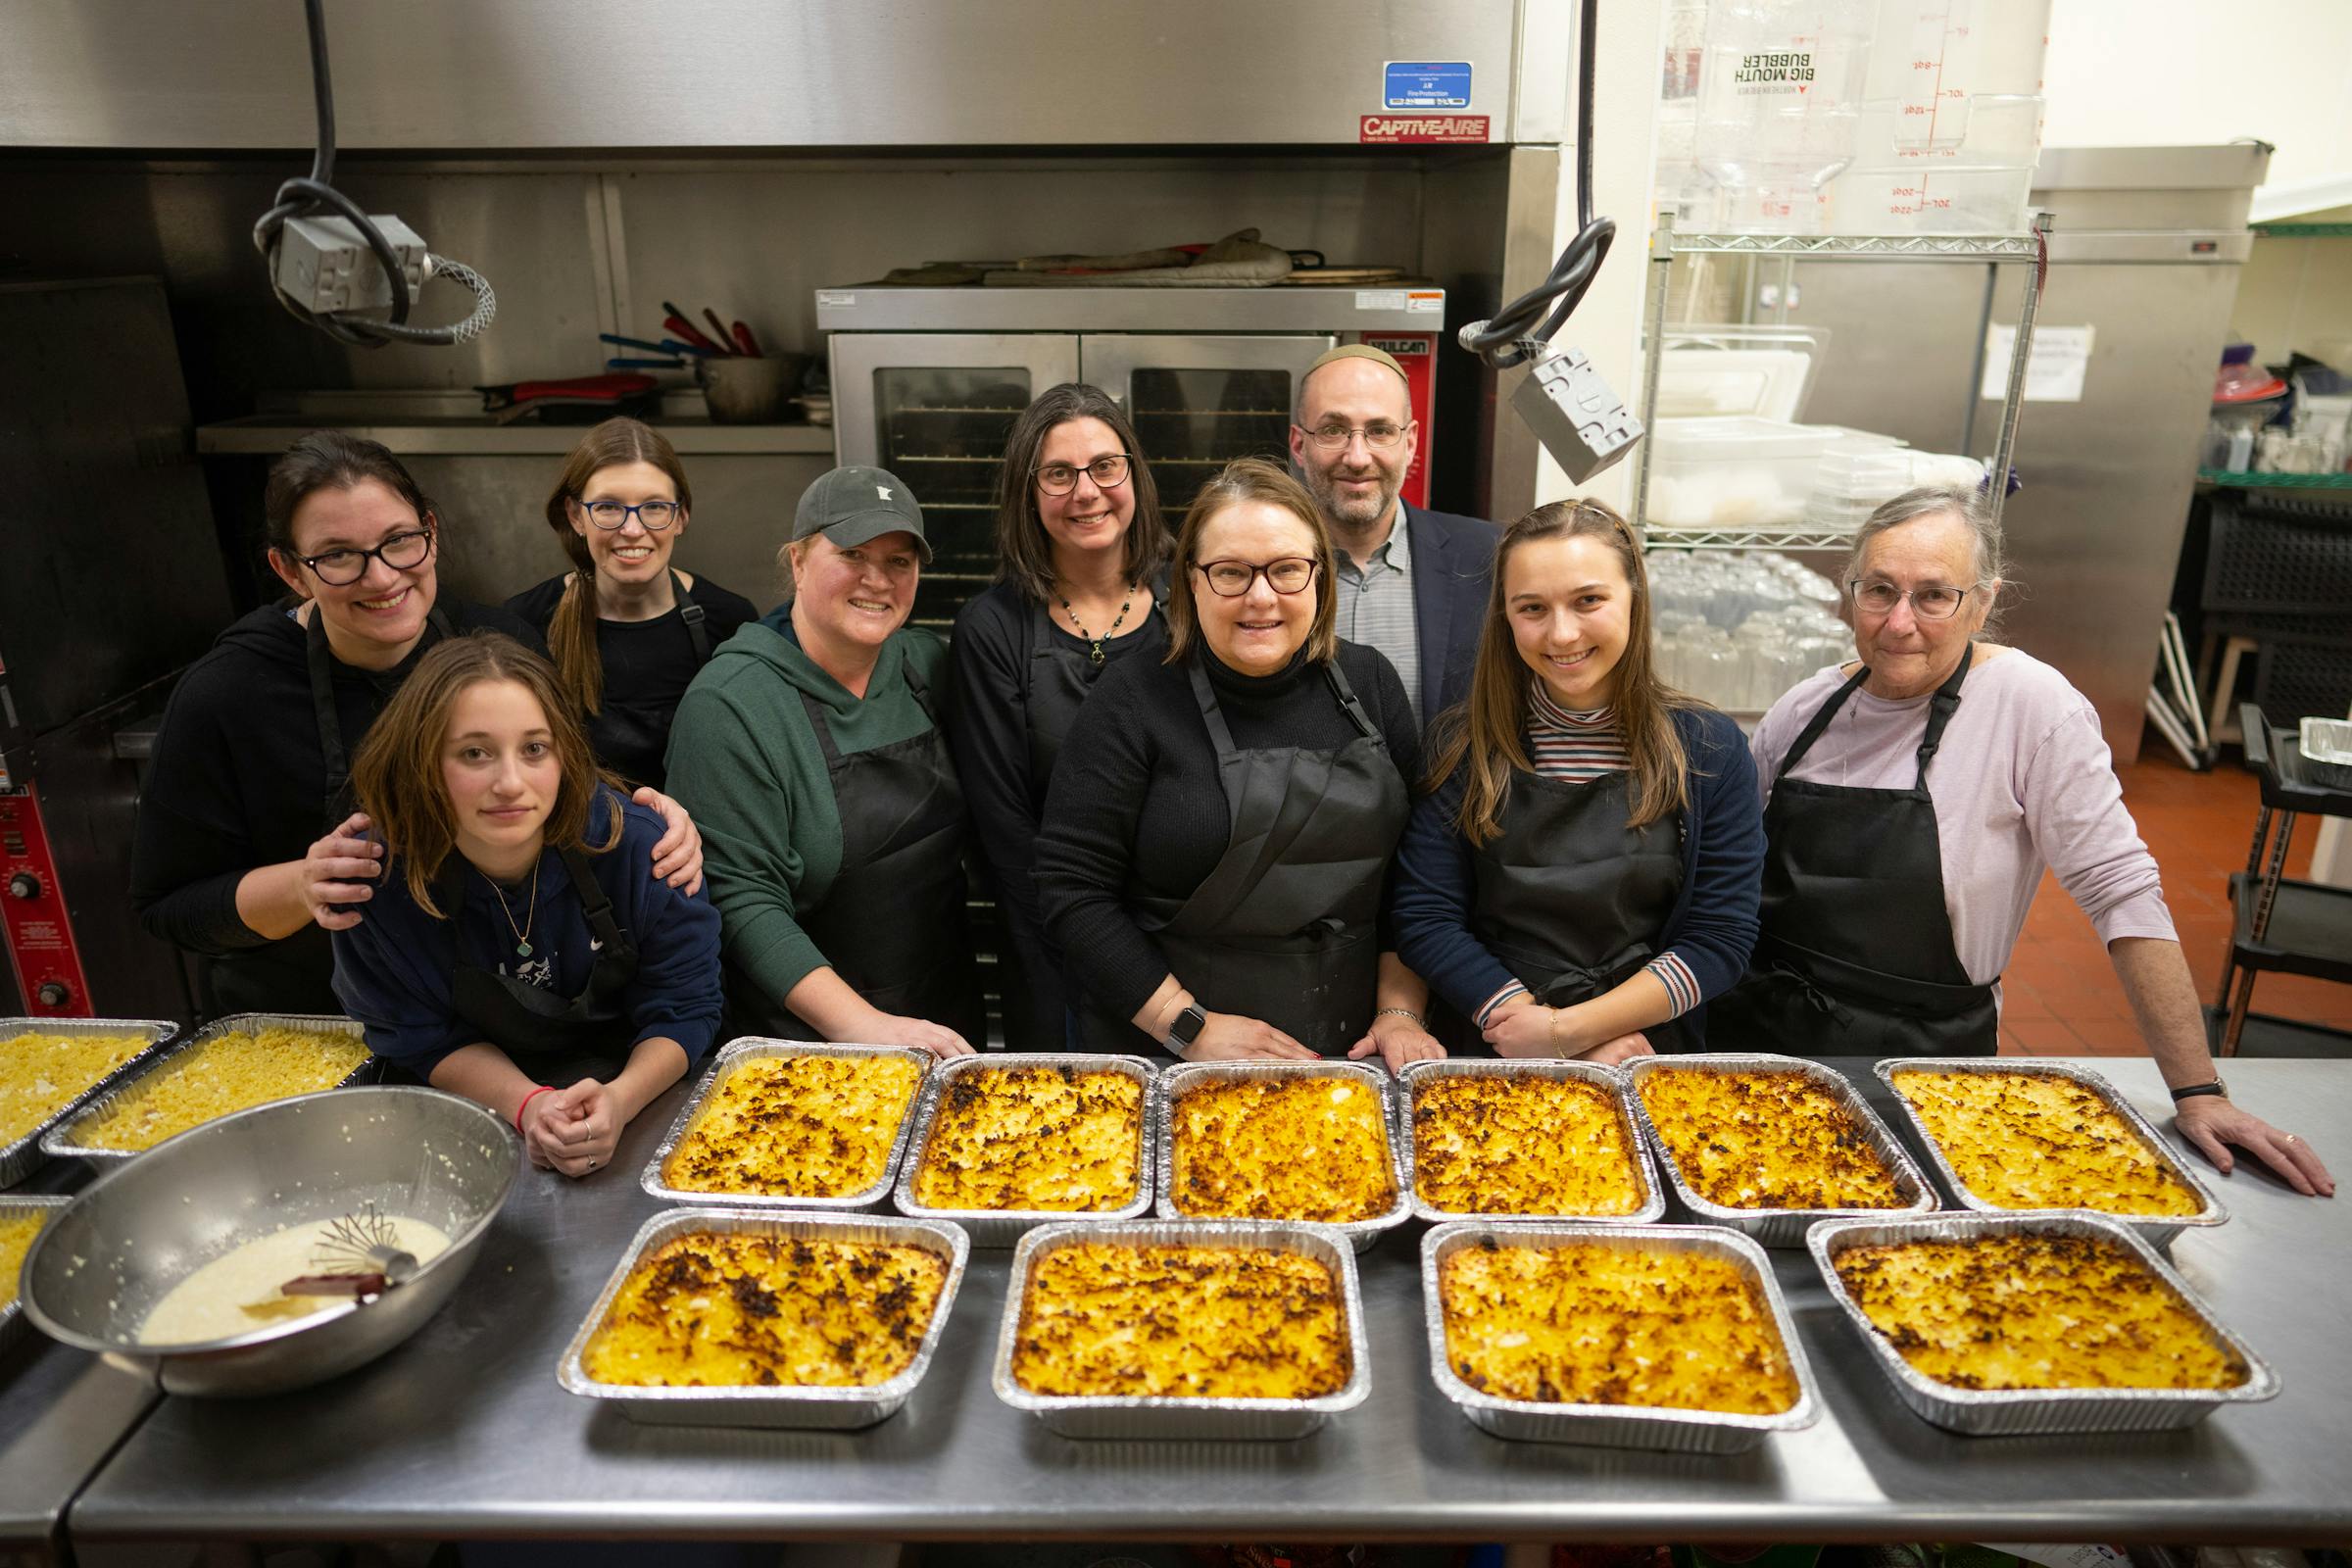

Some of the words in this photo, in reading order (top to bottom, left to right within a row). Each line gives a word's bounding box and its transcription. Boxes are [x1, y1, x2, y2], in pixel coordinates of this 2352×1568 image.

[1743, 54, 1811, 68] BUBBLER
[1735, 69, 1787, 82] MOUTH
[1790, 68, 1815, 81] BIG
[1933, 200, 1951, 209] 20L
